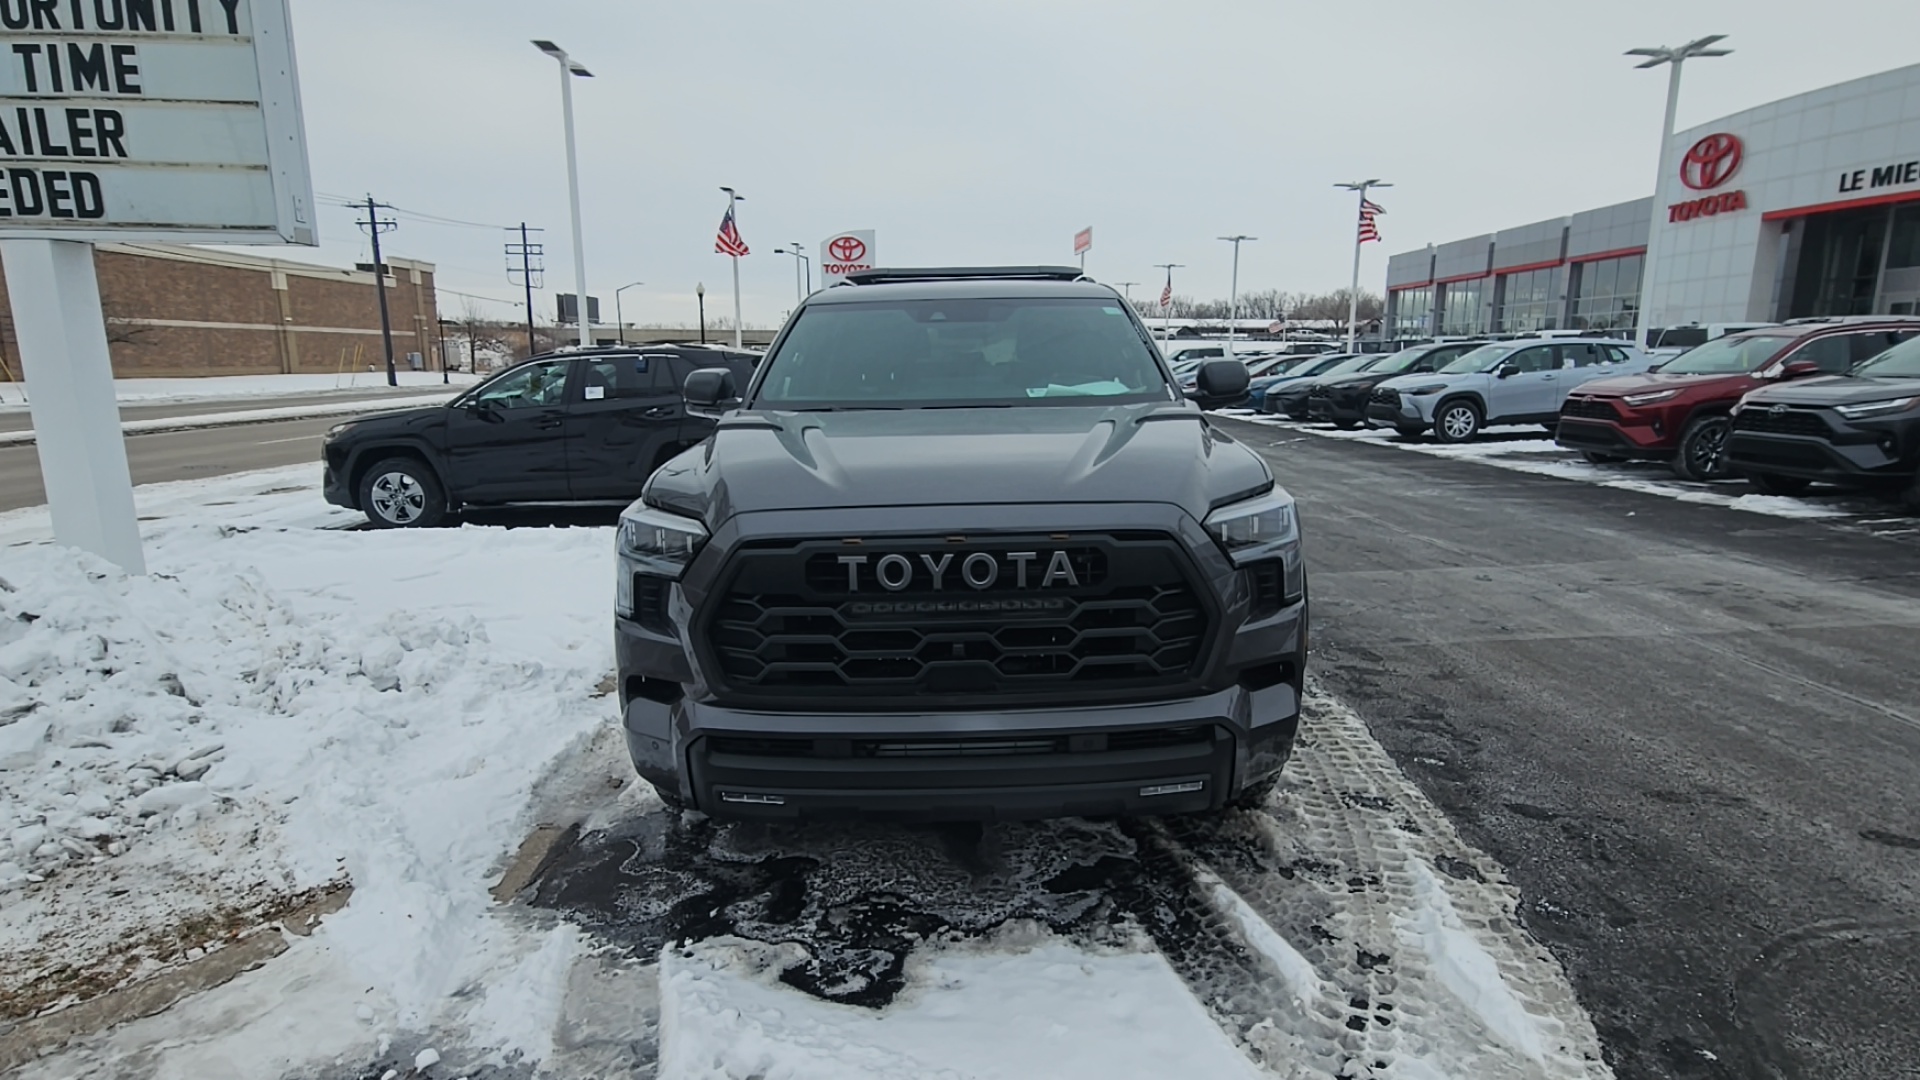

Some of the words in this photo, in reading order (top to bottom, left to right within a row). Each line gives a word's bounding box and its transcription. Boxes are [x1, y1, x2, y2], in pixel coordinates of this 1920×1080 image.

[12, 43, 142, 94] TIME
[1839, 169, 1866, 193] LE
[1870, 161, 1920, 188] MIE
[1668, 190, 1747, 223] TOYOTA
[838, 551, 1079, 591] TOYOTA
